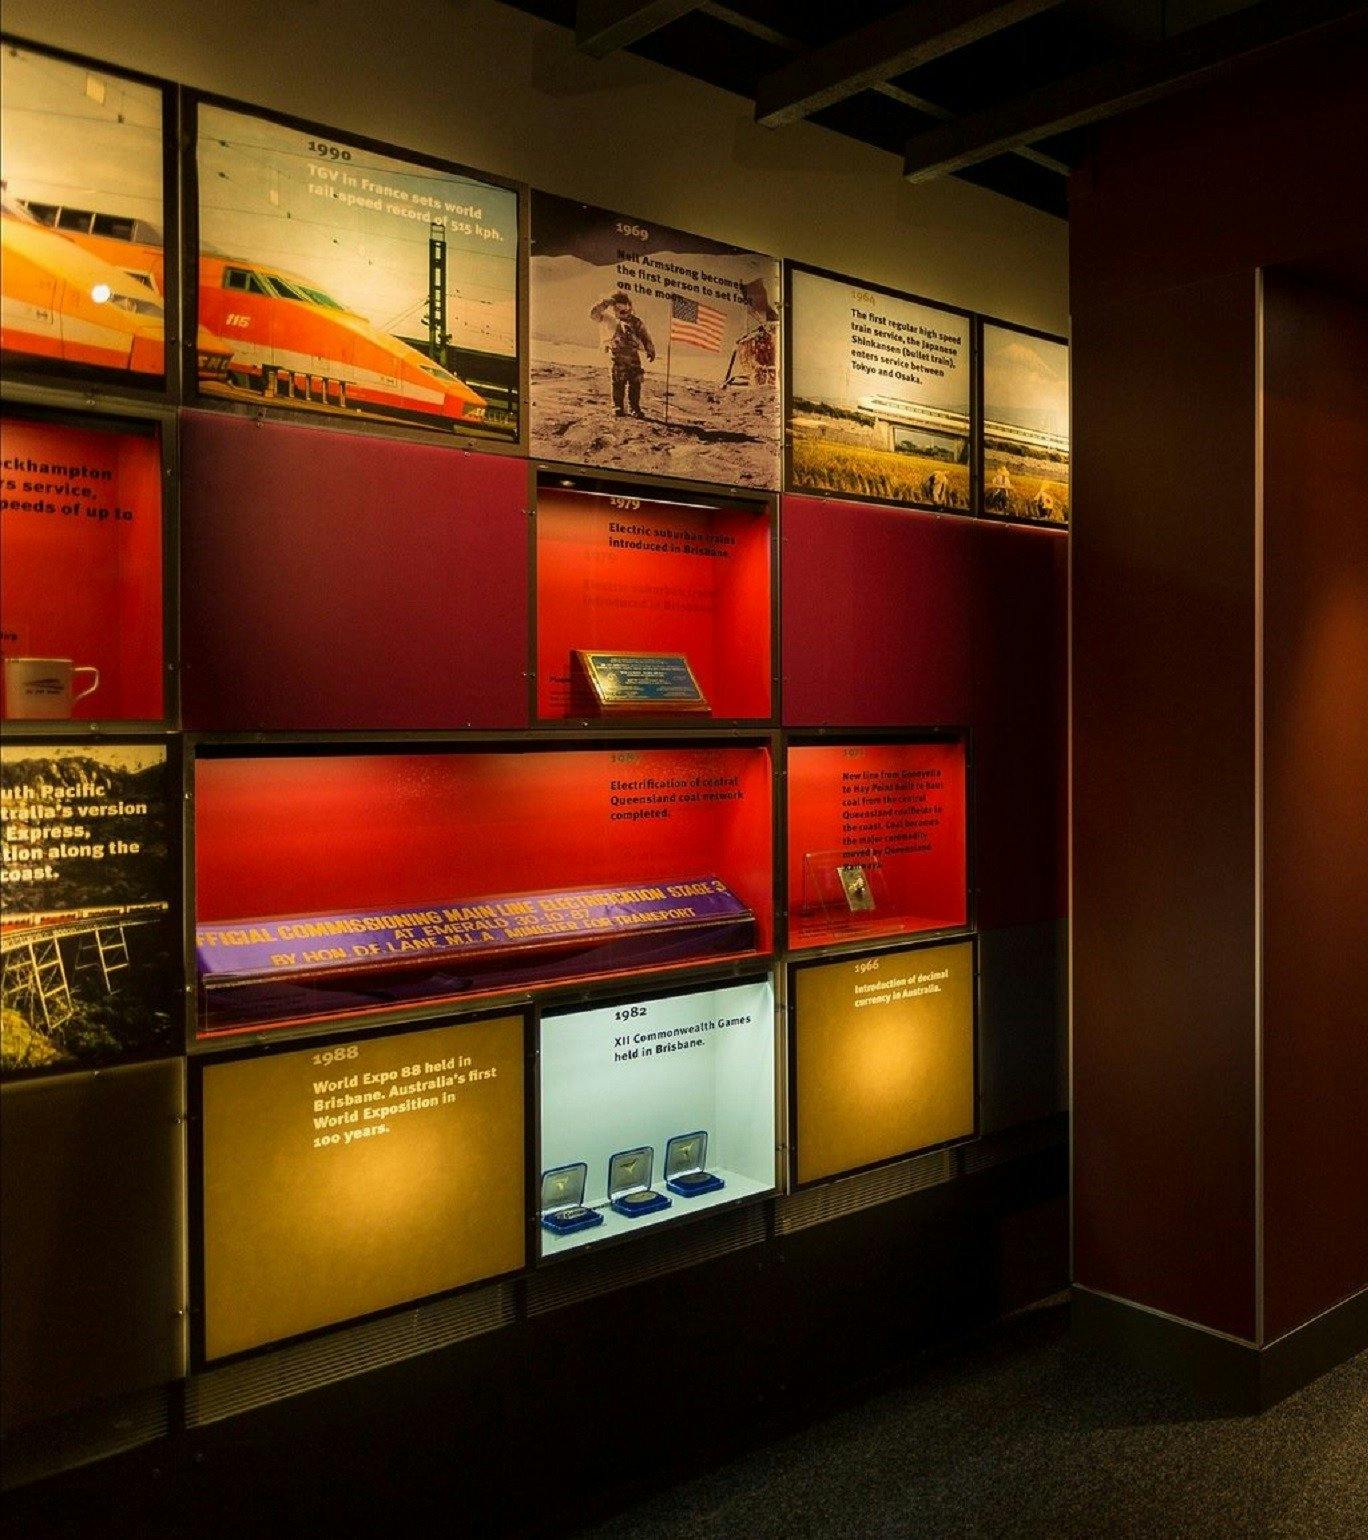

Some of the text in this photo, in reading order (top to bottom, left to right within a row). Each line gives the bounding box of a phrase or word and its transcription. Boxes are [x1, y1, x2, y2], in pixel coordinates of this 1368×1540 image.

[308, 141, 351, 161] 1990
[308, 163, 482, 219] TGV in France sets world
[309, 183, 334, 199] rail
[337, 193, 382, 212] speed
[386, 205, 431, 223] record
[434, 214, 449, 226] of
[615, 222, 649, 241] 1969
[643, 256, 699, 281] Armstrong
[617, 264, 636, 277] the
[638, 269, 662, 284] first
[664, 277, 700, 293] person
[702, 285, 713, 296] to
[715, 289, 731, 300] set
[617, 281, 631, 291] on
[634, 283, 652, 296] the
[851, 308, 962, 346] The first regular high speed
[851, 322, 872, 334] train
[906, 336, 920, 347] the
[921, 340, 958, 356] Japanese
[851, 335, 901, 353] Shinkansen
[851, 350, 945, 377] enters service between
[851, 360, 877, 375] Tokyo
[878, 368, 894, 378] and
[23, 481, 97, 500] service,
[61, 502, 81, 516] of
[86, 507, 109, 520] up
[114, 508, 133, 521] to
[609, 522, 651, 536] Electric
[608, 537, 668, 552] introduced
[1, 783, 106, 799] uth Pacific
[611, 778, 687, 791] Electrification
[0, 801, 148, 821] tralia's version
[611, 794, 676, 806] Queensland
[6, 824, 91, 844] Express,
[2, 840, 140, 862] tion along the
[0, 865, 60, 883] coast.
[277, 911, 442, 942] COMMISSIONING
[442, 905, 497, 922] MAIN
[539, 887, 667, 911] ELECTRIFICATION
[667, 881, 714, 898] STAGE
[271, 952, 296, 967] BY
[302, 947, 348, 962] HON
[385, 936, 438, 953] LANE
[504, 921, 578, 939] MINISTER
[583, 917, 613, 928] FOR
[615, 907, 696, 925] TRANSPORT
[395, 928, 414, 940] AT
[421, 918, 509, 938] EMERALD
[854, 977, 907, 994] Introduction
[917, 969, 949, 982] decimal
[615, 1007, 647, 1021] 1982
[614, 1015, 751, 1048] XII Commonwealth Games
[313, 1045, 360, 1067] 1988
[614, 1038, 706, 1062] held in Brisbane.
[313, 1055, 472, 1095] World Expo 88 held in
[313, 1067, 498, 1112] Brisbane. Australia's first
[313, 1091, 457, 1130] World Exposition in
[344, 1123, 391, 1145] years.
